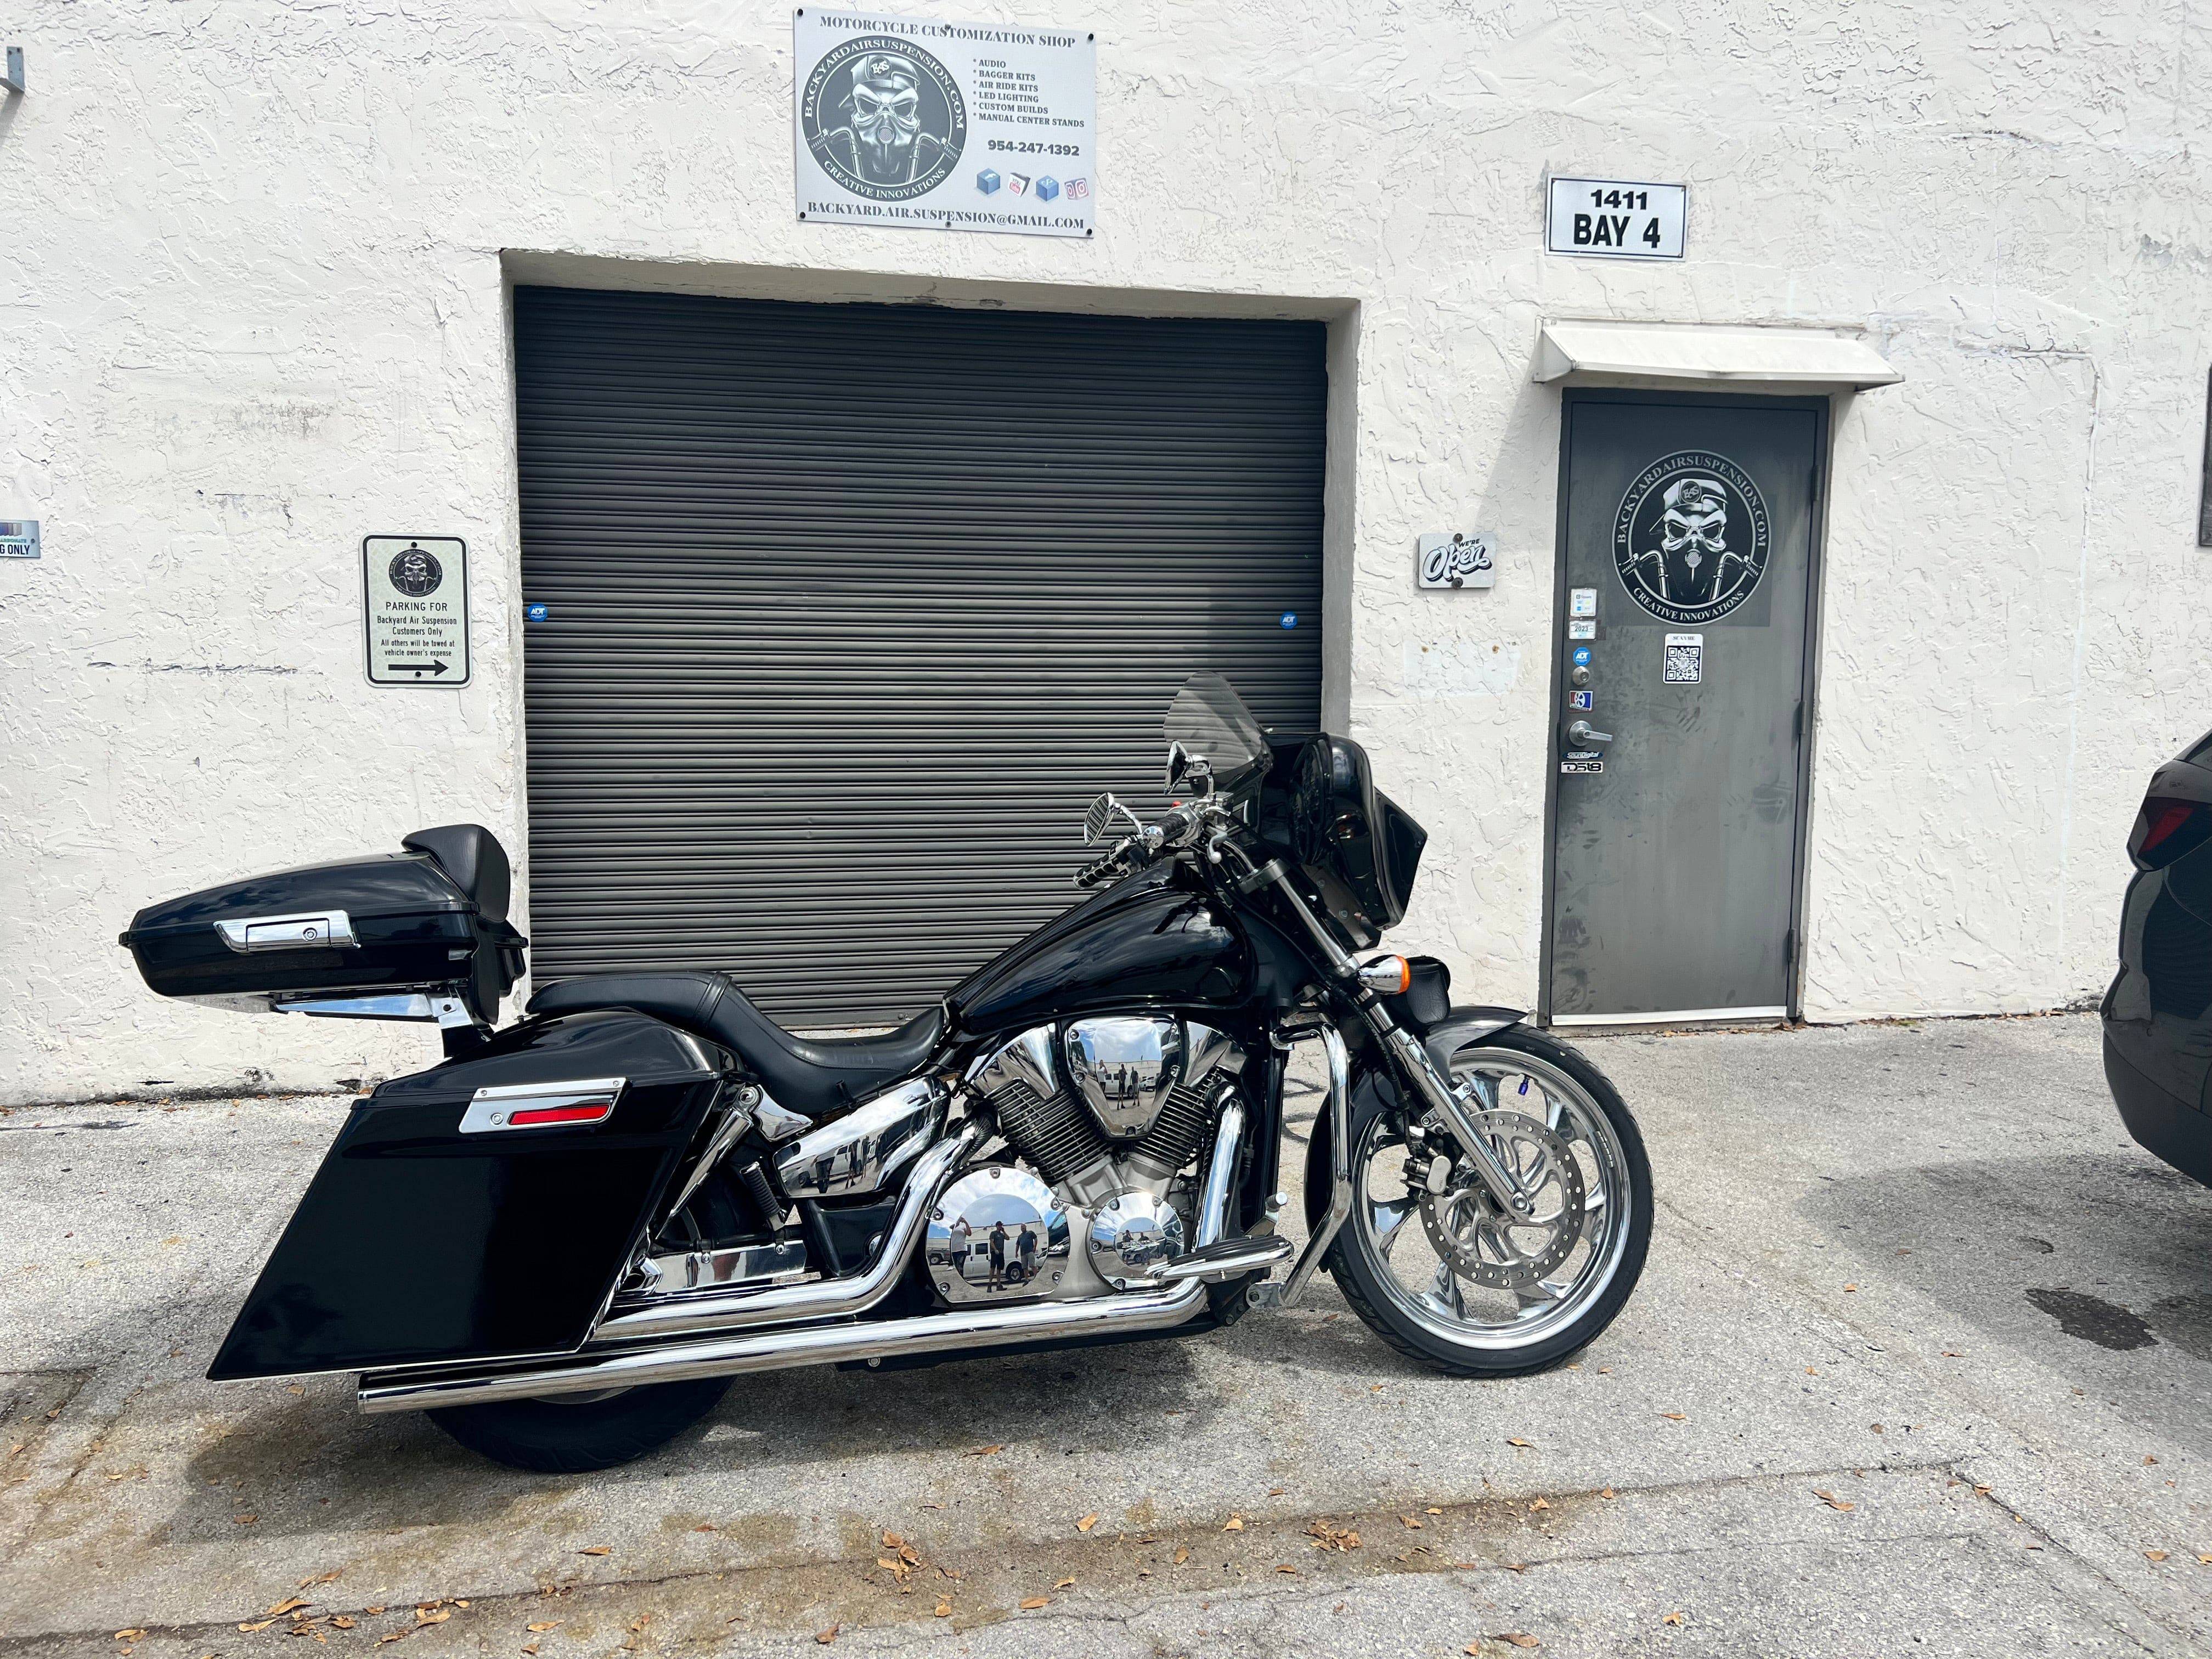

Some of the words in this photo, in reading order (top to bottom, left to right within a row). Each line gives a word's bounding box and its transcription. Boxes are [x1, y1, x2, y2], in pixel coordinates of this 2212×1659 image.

[820, 16, 918, 35] MOTORCYCLE
[922, 25, 1035, 45] CUSTOMIZATION
[1039, 36, 1076, 48] SHOP
[979, 59, 1006, 68] AUDIO
[979, 70, 1014, 80] BAGGER
[1016, 73, 1036, 81] KITS
[805, 40, 964, 129] BACKYARDAIRSUSPENSION.COM
[996, 82, 1017, 91] RIDE
[1019, 84, 1039, 92] KITS
[998, 93, 1039, 103] LIGHTING
[979, 103, 1014, 112] CUSTOM
[1017, 105, 1048, 114] BUILDS
[979, 113, 1014, 122] MANUAL
[1017, 116, 1050, 125] CENTER
[1052, 119, 1085, 127] STANDS
[988, 139, 1080, 156] 954-247-1392
[823, 160, 873, 196] CREATIVE
[876, 167, 946, 199] INNOVATIONS
[1590, 189, 1647, 210] 1411
[807, 202, 1085, 229] BACKYARD.AIR.SUSPENSION@GMAIL.COM
[1573, 213, 1631, 247] BAY
[1643, 217, 1661, 249] 4
[1617, 455, 1767, 548] BACKYARDAIRSUSPENSION.COM
[1458, 538, 1480, 548] WE'RE
[8, 544, 30, 555] ONLY
[1423, 543, 1493, 582] Open
[386, 601, 426, 611] PARKING
[430, 602, 448, 612] FOR
[1633, 587, 1679, 621] CREATIVE
[1679, 590, 1745, 621] INNOVATIONS
[377, 615, 407, 626] Backyard
[410, 616, 419, 624] Air
[422, 616, 457, 626] Suspension
[392, 627, 425, 635] Customers
[428, 627, 443, 637] Only
[1562, 763, 1601, 771] DS18
